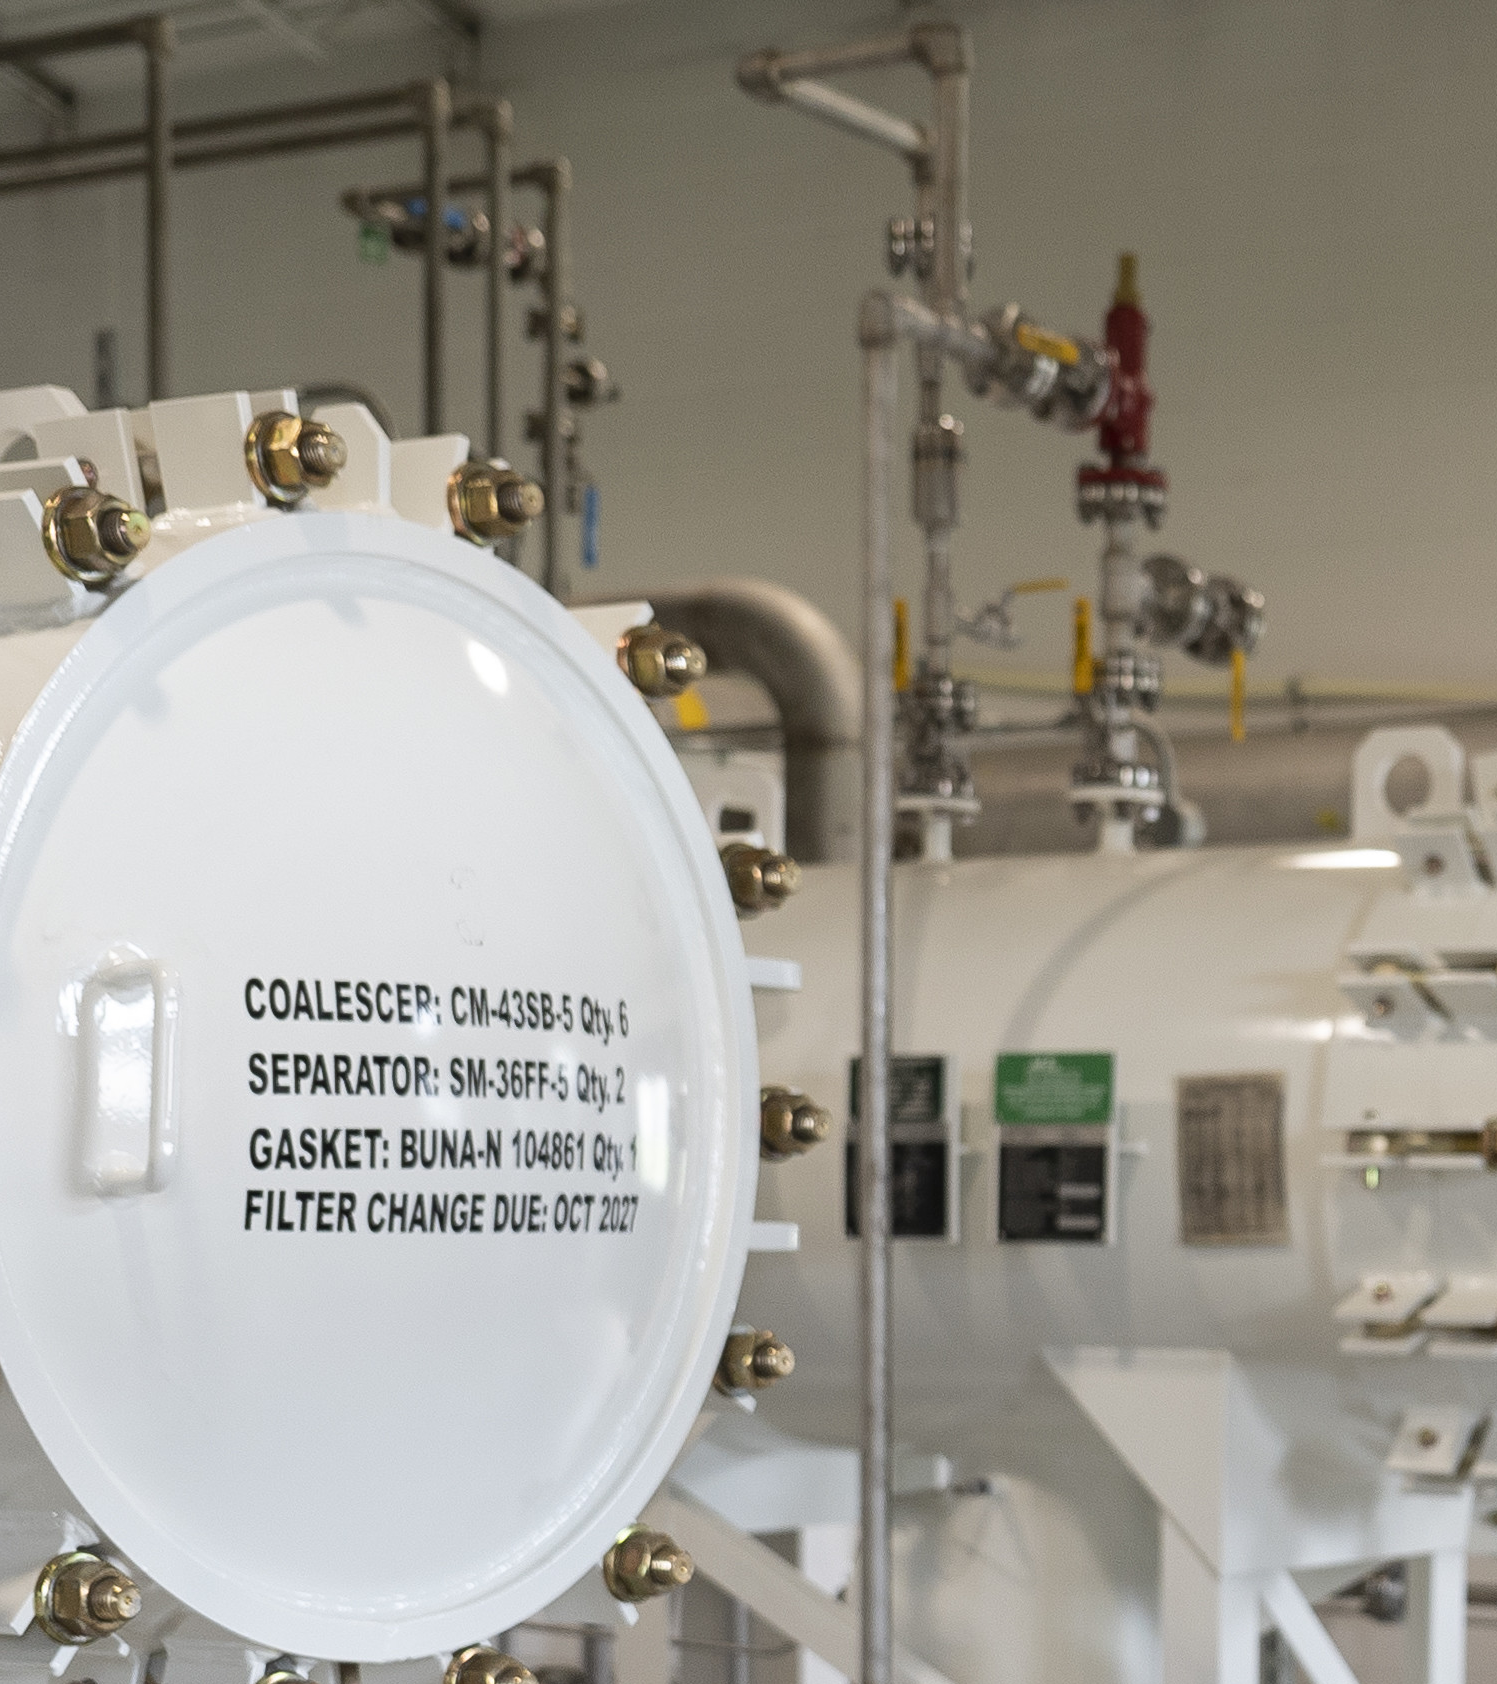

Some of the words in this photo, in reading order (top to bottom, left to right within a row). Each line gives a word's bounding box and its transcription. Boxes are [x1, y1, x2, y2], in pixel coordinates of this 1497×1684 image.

[244, 977, 442, 1025] COALESCER:
[450, 986, 574, 1033] CM-43SB-5
[581, 996, 614, 1046] Qty.
[619, 1000, 629, 1038] 6
[248, 1053, 440, 1097] SEPARATOR:
[450, 1057, 569, 1101] SM-36FF-5
[576, 1063, 611, 1113] Qty.
[615, 1066, 625, 1104] 2
[249, 1128, 389, 1170] GASKET:
[401, 1128, 502, 1169] BUNA-N
[512, 1129, 585, 1171] 104861
[593, 1133, 624, 1182] Qty.
[630, 1133, 638, 1171] 1
[244, 1190, 357, 1232] FILTER
[367, 1192, 486, 1233] CHANGE
[493, 1194, 548, 1233] DUE:
[554, 1194, 595, 1233] OCT
[598, 1194, 639, 1233] 2027
